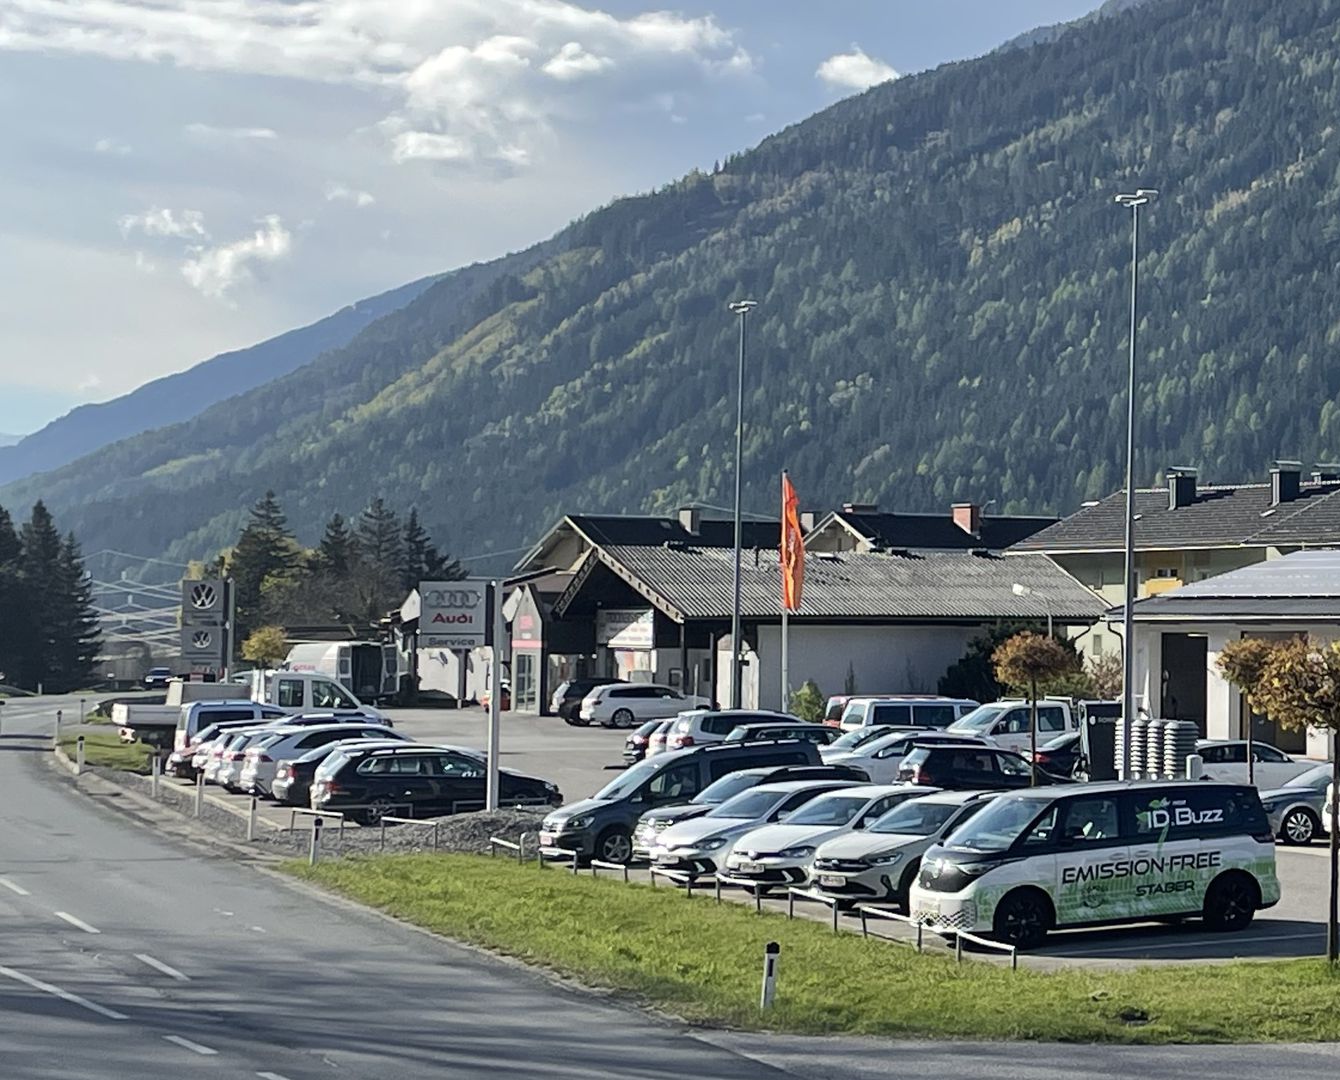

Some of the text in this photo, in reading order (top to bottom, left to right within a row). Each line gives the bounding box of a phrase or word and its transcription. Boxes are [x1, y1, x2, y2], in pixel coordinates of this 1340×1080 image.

[432, 613, 473, 624] Audi
[428, 637, 476, 647] Service
[1148, 807, 1224, 829] ID.Buzz
[1062, 851, 1222, 885] EMISSION-FREE
[1135, 880, 1196, 897] STABER
